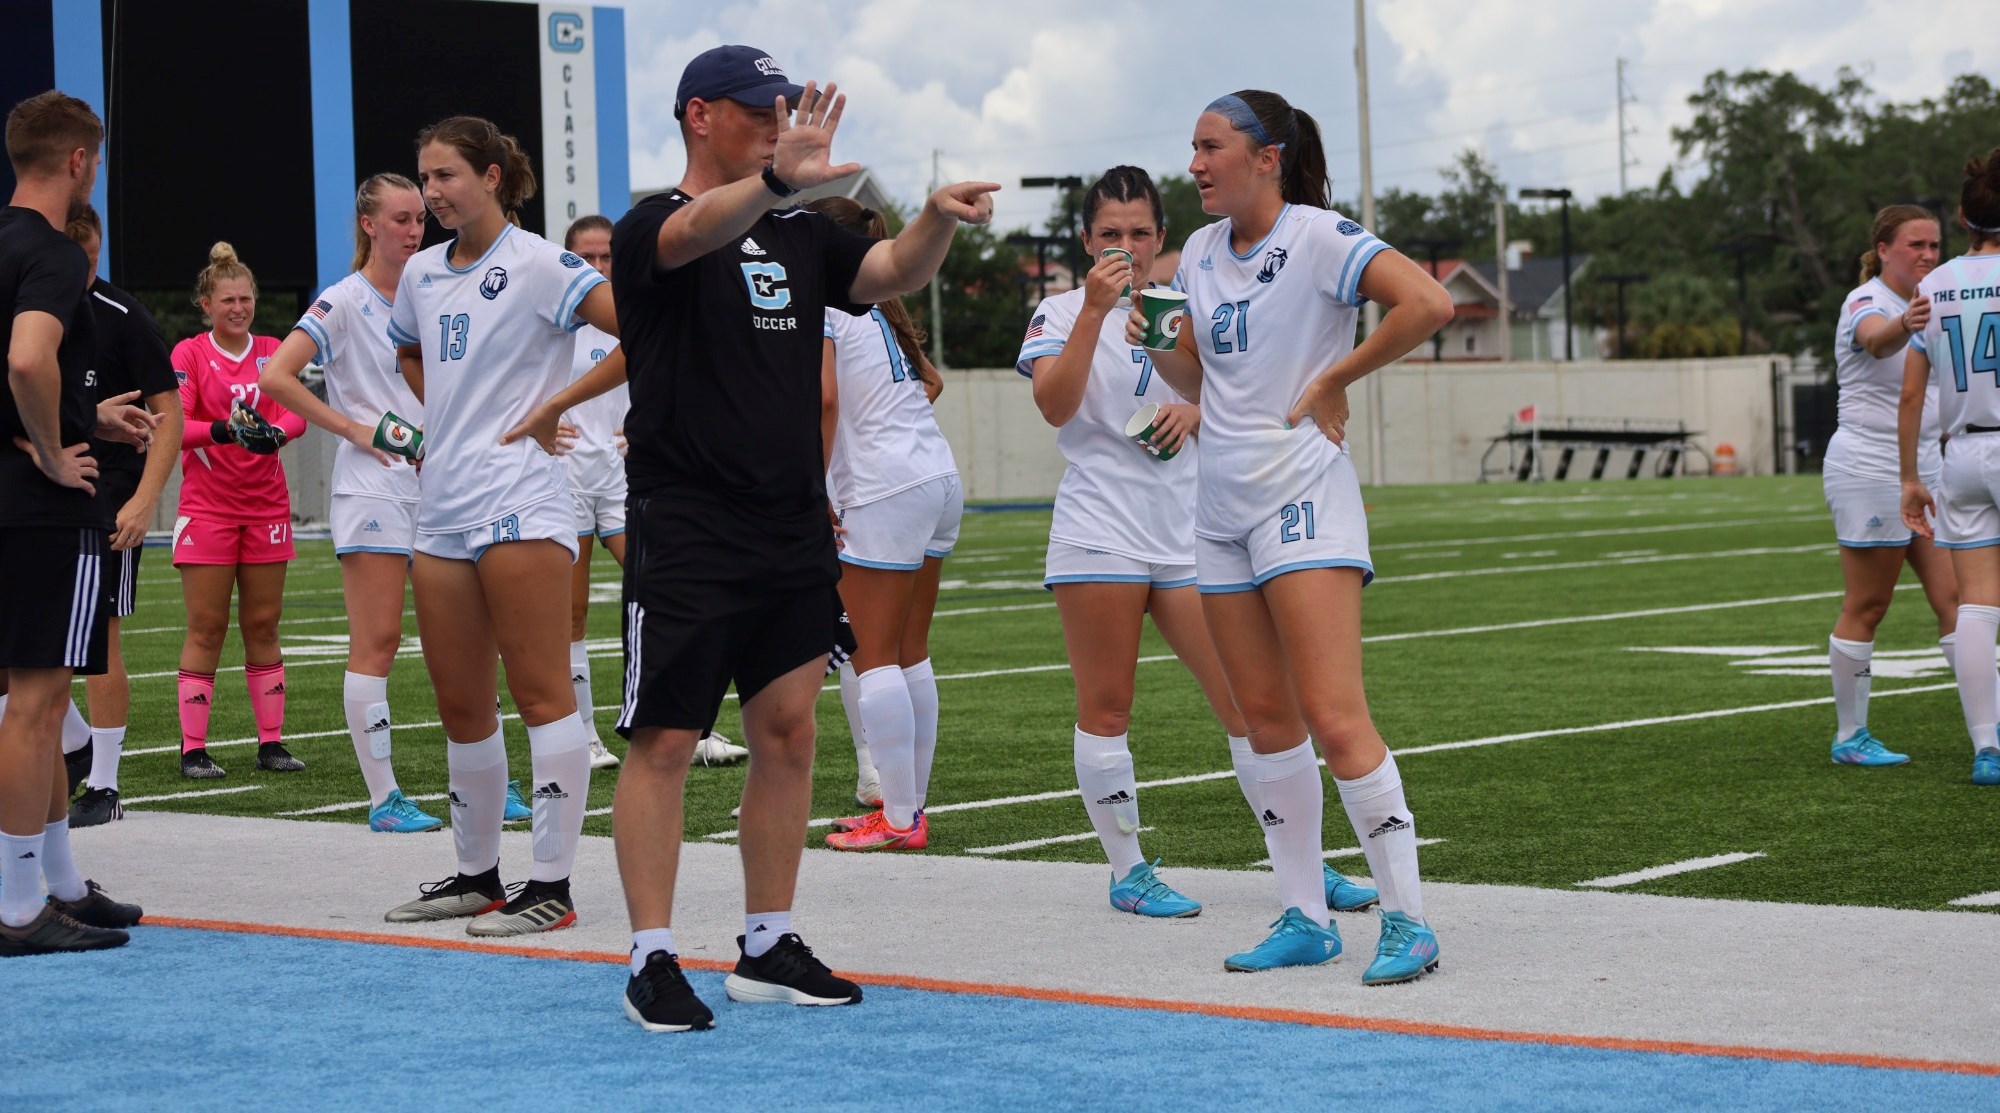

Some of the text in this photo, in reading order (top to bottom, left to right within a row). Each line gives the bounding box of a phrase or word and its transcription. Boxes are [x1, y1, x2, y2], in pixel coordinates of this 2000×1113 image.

[548, 12, 584, 53] C
[562, 64, 576, 184] CLASS
[740, 261, 791, 310] C
[1933, 289, 1956, 303] THE
[439, 313, 470, 362] 13
[753, 315, 797, 330] OCCER
[1211, 300, 1250, 354] 21
[1131, 349, 1154, 396] 7
[1940, 311, 2000, 393] 14
[230, 383, 261, 413] 27
[268, 523, 287, 544] 27
[493, 514, 521, 543] 13
[1280, 501, 1315, 544] 21
[1096, 796, 1134, 805] adidas
[1368, 821, 1410, 839] adidas
